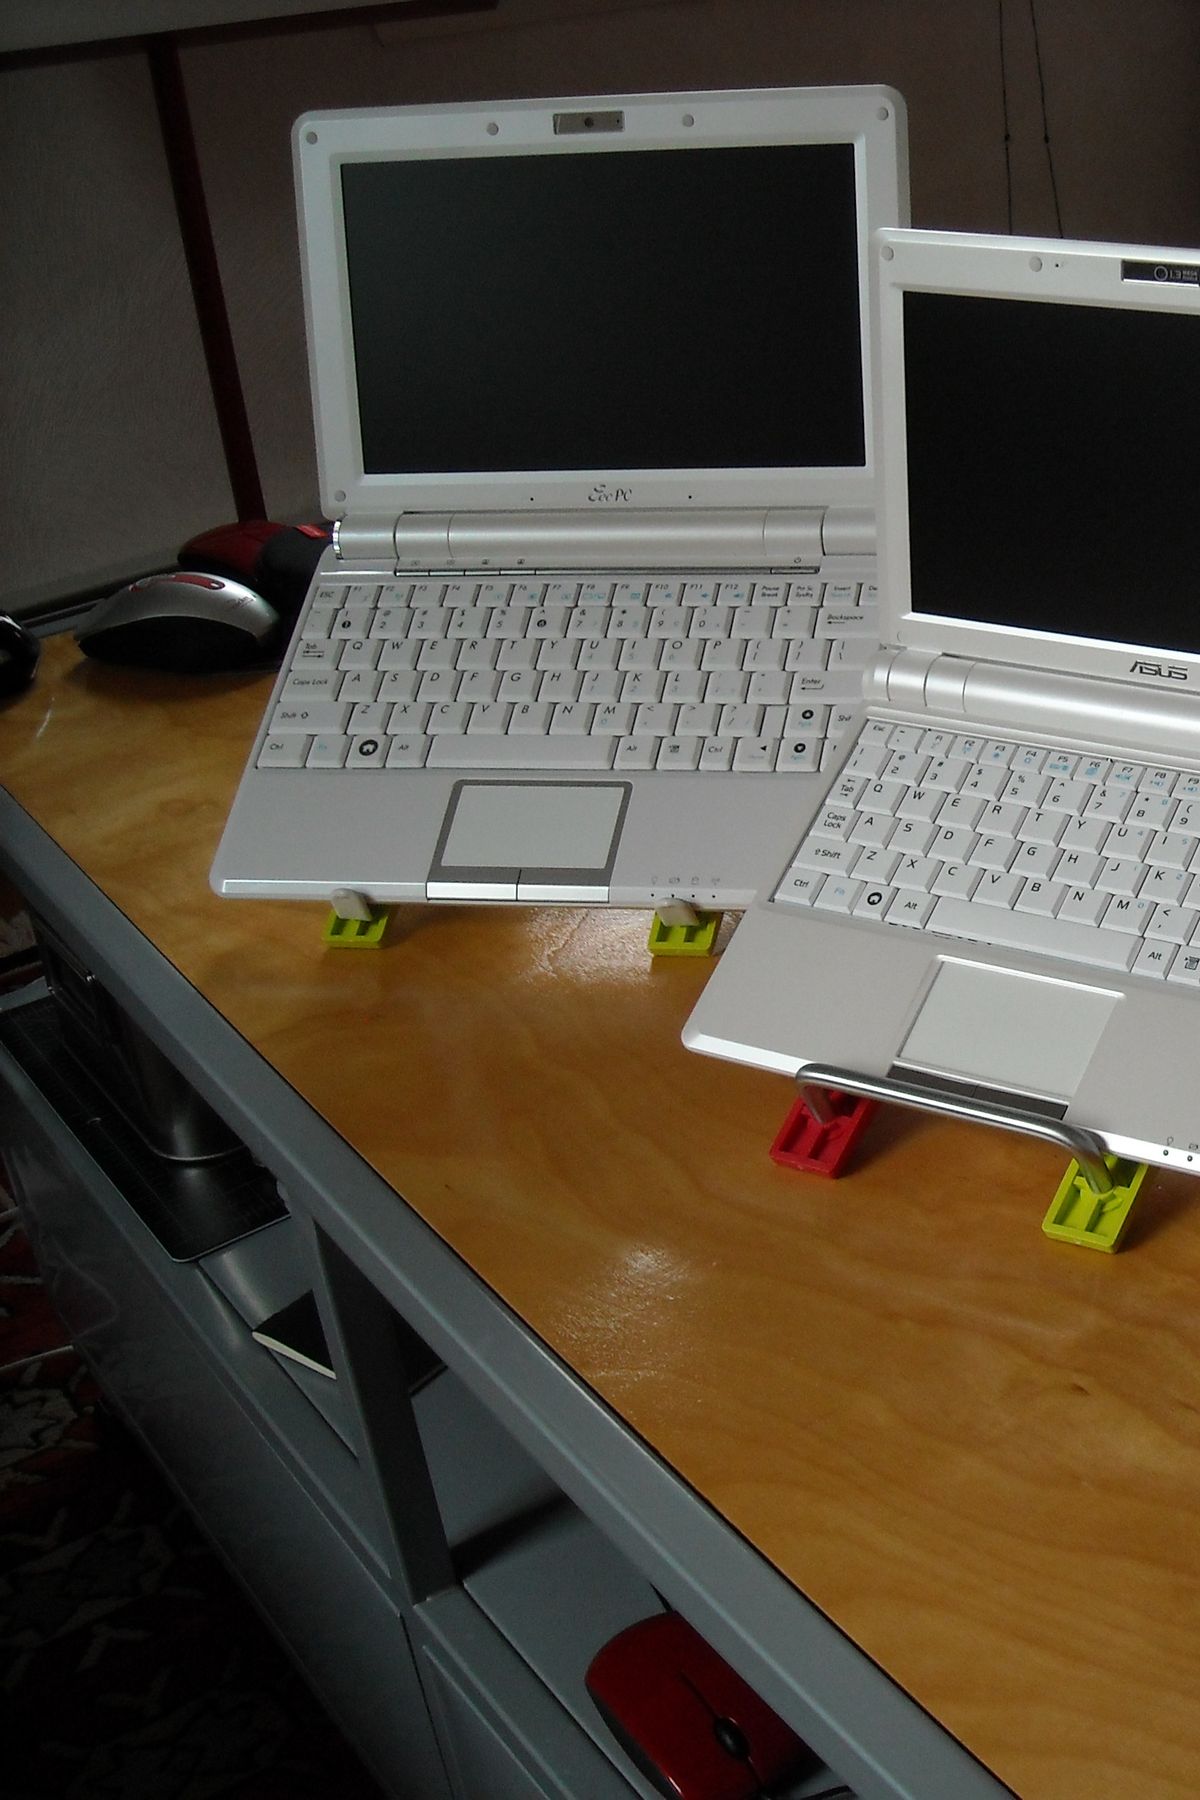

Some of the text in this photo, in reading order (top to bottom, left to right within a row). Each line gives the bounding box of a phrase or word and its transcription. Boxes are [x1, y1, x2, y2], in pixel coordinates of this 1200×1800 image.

[615, 488, 632, 502] PC
[353, 641, 363, 650] Q
[392, 641, 403, 649] W
[430, 641, 437, 649] E
[470, 641, 478, 649] R
[672, 641, 682, 649] O
[1129, 660, 1188, 680] ASUS
[352, 674, 360, 682] A
[430, 674, 440, 682] D
[510, 673, 521, 682] G
[633, 673, 642, 682] K
[400, 705, 409, 713] X
[604, 705, 616, 714] M
[840, 784, 853, 792] Tab
[873, 784, 883, 793] Q
[913, 791, 925, 800] W
[951, 798, 960, 807] E
[992, 806, 1002, 814] R
[827, 812, 846, 822] Caps
[1036, 812, 1043, 821] T
[824, 820, 842, 830] Lock
[864, 817, 873, 826] A
[1078, 820, 1086, 829] Y
[904, 823, 912, 832] S
[944, 830, 953, 840] D
[1118, 828, 1128, 837] U
[984, 838, 994, 847] F
[821, 850, 841, 860] Shift
[867, 851, 876, 860] Z
[1027, 847, 1036, 856] G
[907, 859, 918, 868] X
[1068, 854, 1078, 864] H
[948, 867, 958, 876] C
[1111, 863, 1120, 872] J
[991, 874, 1001, 884] V
[1155, 871, 1165, 880] K
[794, 879, 809, 888] Ctrl
[1031, 882, 1041, 892] B
[1073, 892, 1084, 901] N
[905, 902, 918, 910] Alt
[1117, 900, 1130, 910] M
[1148, 951, 1162, 960] Alt
